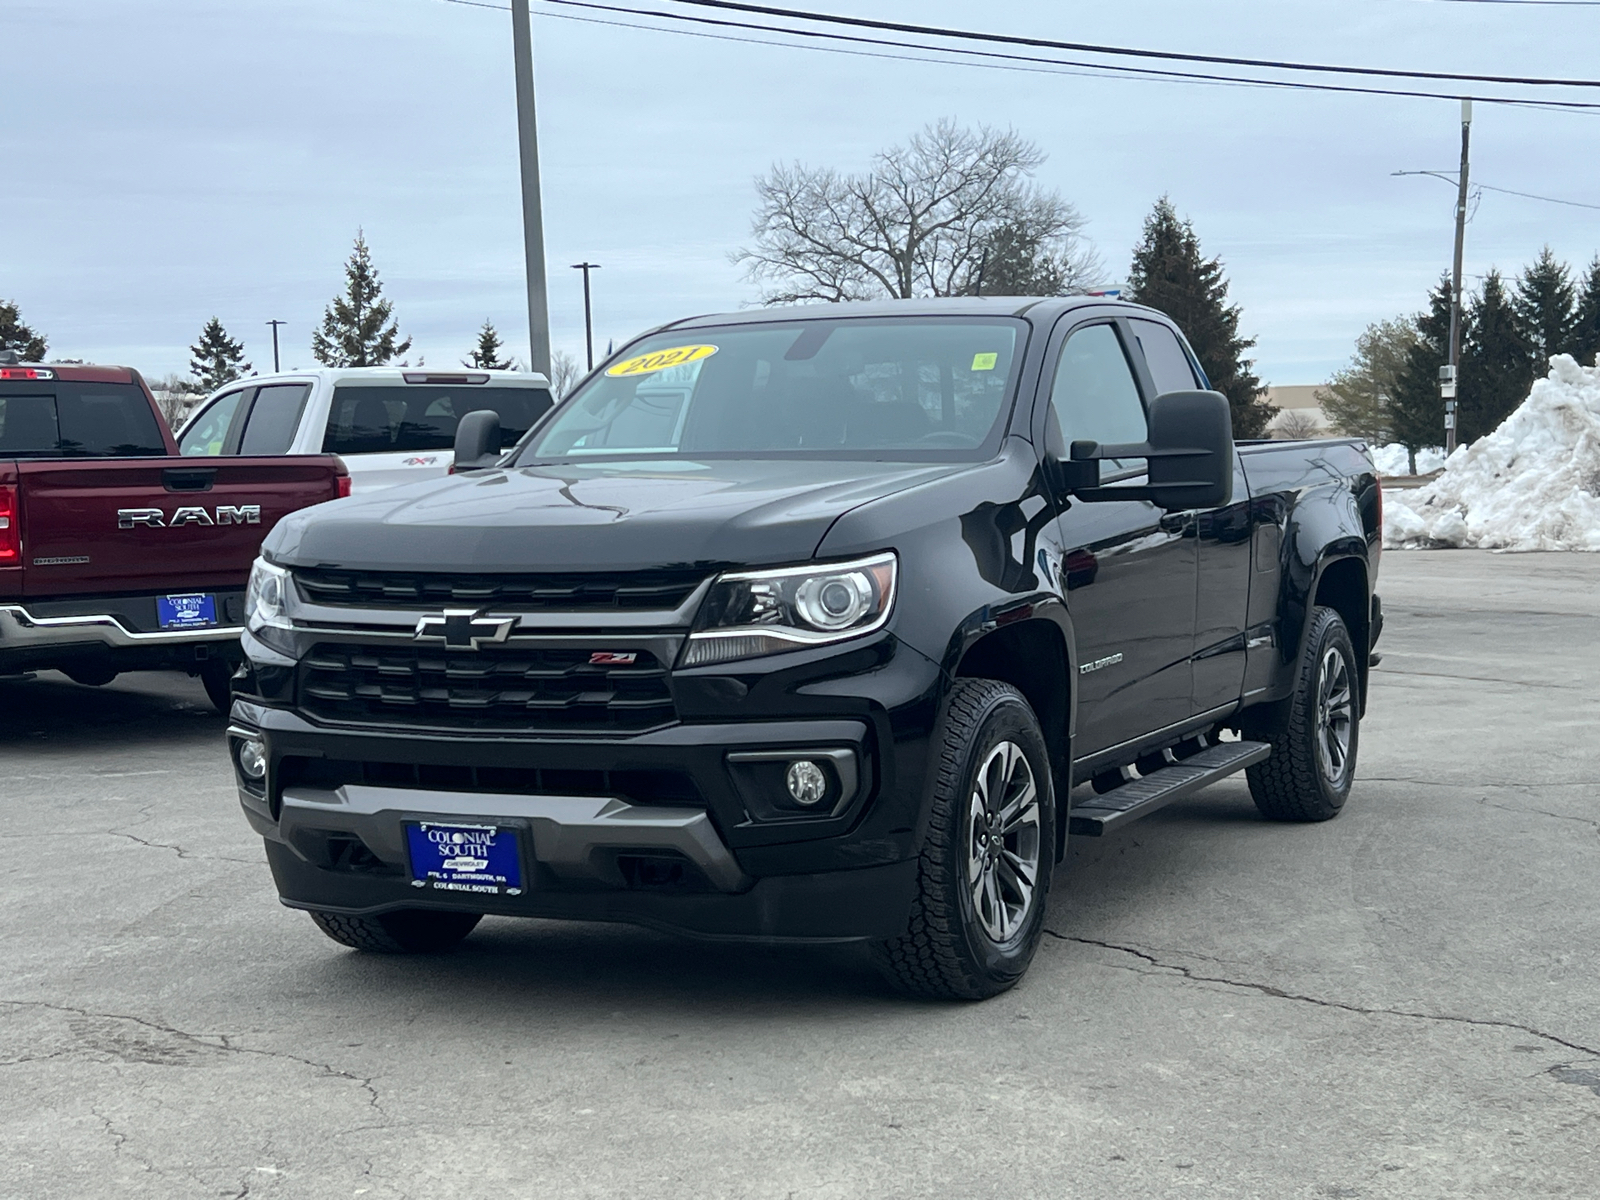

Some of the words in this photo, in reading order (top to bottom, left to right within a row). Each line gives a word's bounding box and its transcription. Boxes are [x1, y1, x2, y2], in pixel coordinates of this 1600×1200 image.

[620, 347, 701, 374] 2021
[117, 504, 261, 529] RAM
[169, 597, 204, 605] COLONIAL
[1080, 652, 1123, 674] COLORADO
[428, 830, 496, 845] COLONIAL
[438, 844, 488, 857] SOUTH
[433, 882, 470, 892] COLONIAL
[472, 885, 499, 893] SOUTH
